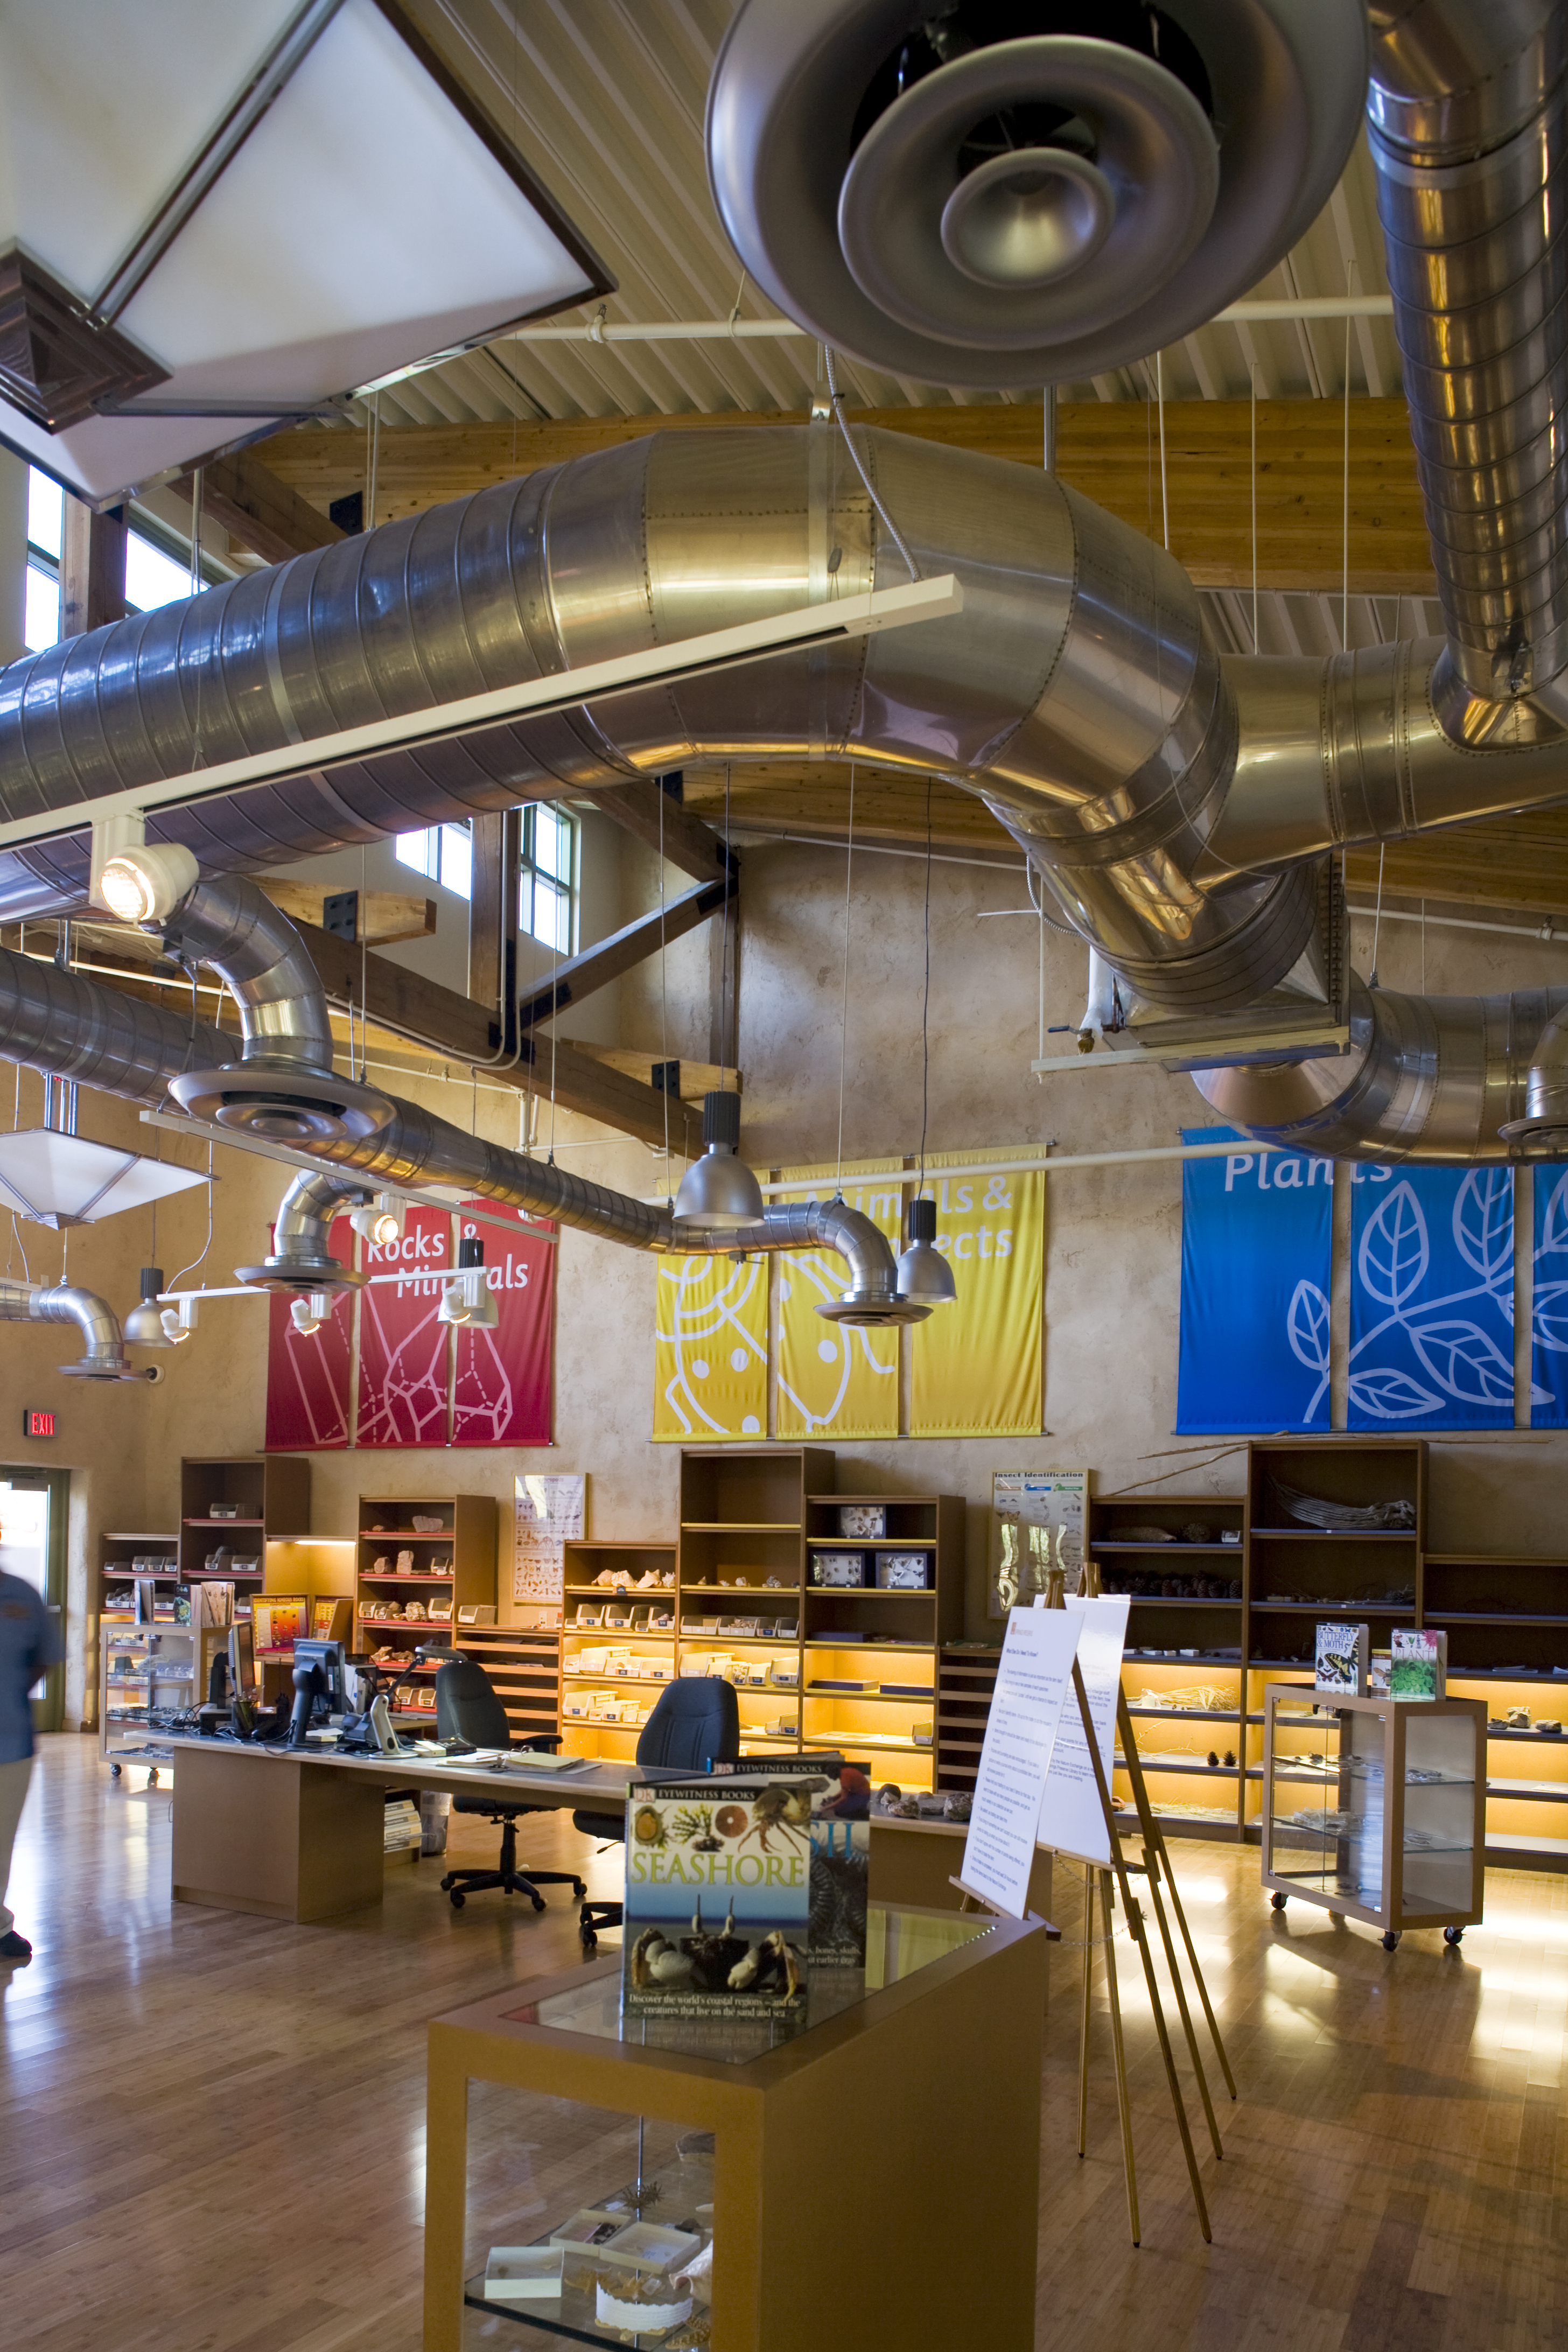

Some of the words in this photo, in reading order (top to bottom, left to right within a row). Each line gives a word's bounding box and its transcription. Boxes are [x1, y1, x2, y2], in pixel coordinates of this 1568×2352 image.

[982, 1176, 1012, 1210] &
[368, 1224, 444, 1263] Rocks
[397, 1254, 528, 1298] Minals
[32, 1413, 55, 1435] EXIT
[1317, 1631, 1354, 1641] BUTTERFLY
[1317, 1639, 1322, 1647] &
[1324, 1640, 1343, 1649] MOTH
[1396, 1648, 1433, 1661] PLANT
[737, 1764, 789, 1773] EYEWITNESS
[792, 1765, 822, 1773] BOOKS
[635, 1788, 653, 1801] DK
[659, 1789, 718, 1800] EYEWITNESS
[722, 1790, 755, 1801] BOOKS
[810, 1821, 863, 1858] SIL
[632, 1852, 804, 1887] SEASHORE
[629, 1993, 662, 2003] Discover
[663, 1994, 675, 2004] the
[706, 1996, 733, 2005] coastal
[735, 1997, 762, 2007] regions
[788, 1998, 801, 2007] the
[643, 2007, 679, 2015] creatures
[681, 2006, 695, 2015] that
[696, 2006, 710, 2016] live
[723, 2007, 736, 2017] the
[737, 2007, 754, 2017] sand
[757, 2008, 771, 2017] and
[773, 2010, 786, 2018] sea
